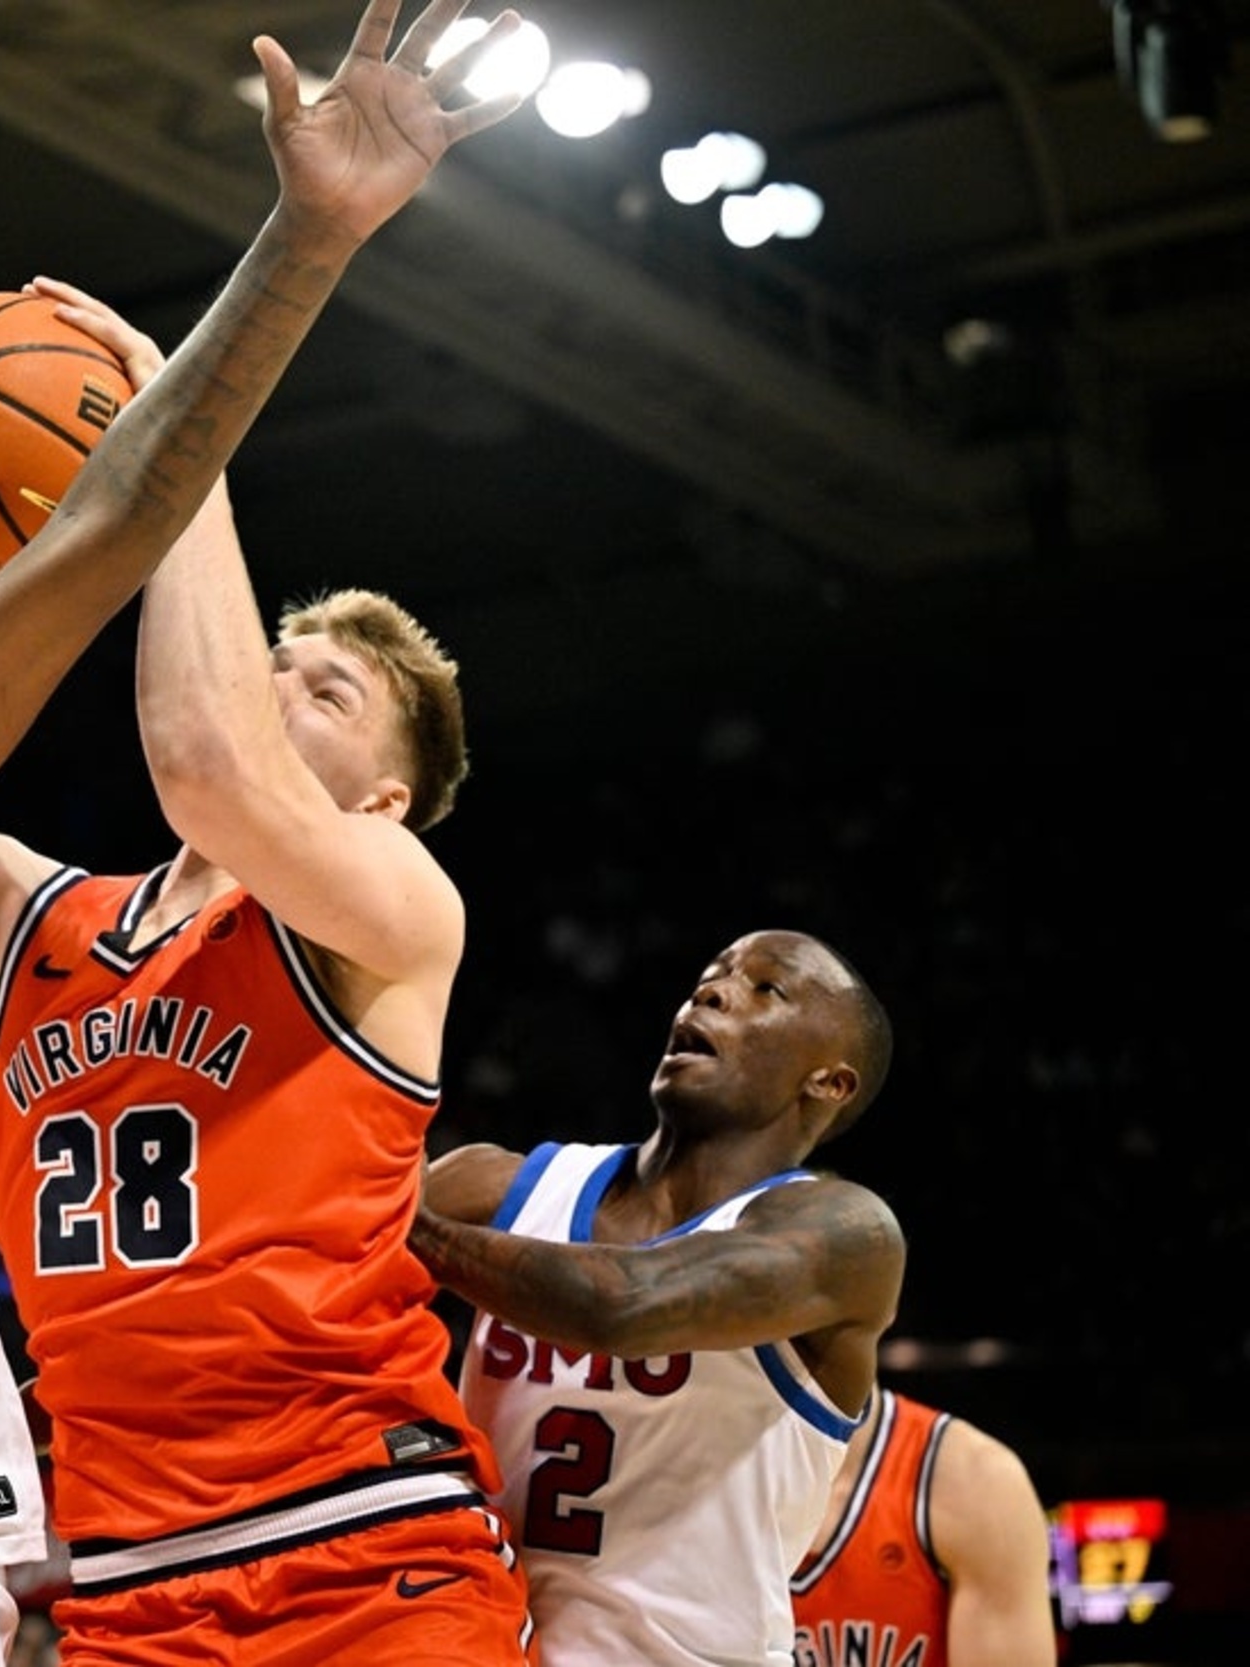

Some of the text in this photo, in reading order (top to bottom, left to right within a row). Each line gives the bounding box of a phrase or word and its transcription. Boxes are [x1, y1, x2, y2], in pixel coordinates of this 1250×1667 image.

[3, 996, 252, 1117] VIRGINIA
[34, 1102, 197, 1276] 28
[523, 1405, 615, 1556] 2
[792, 1618, 930, 1667] GINIA
